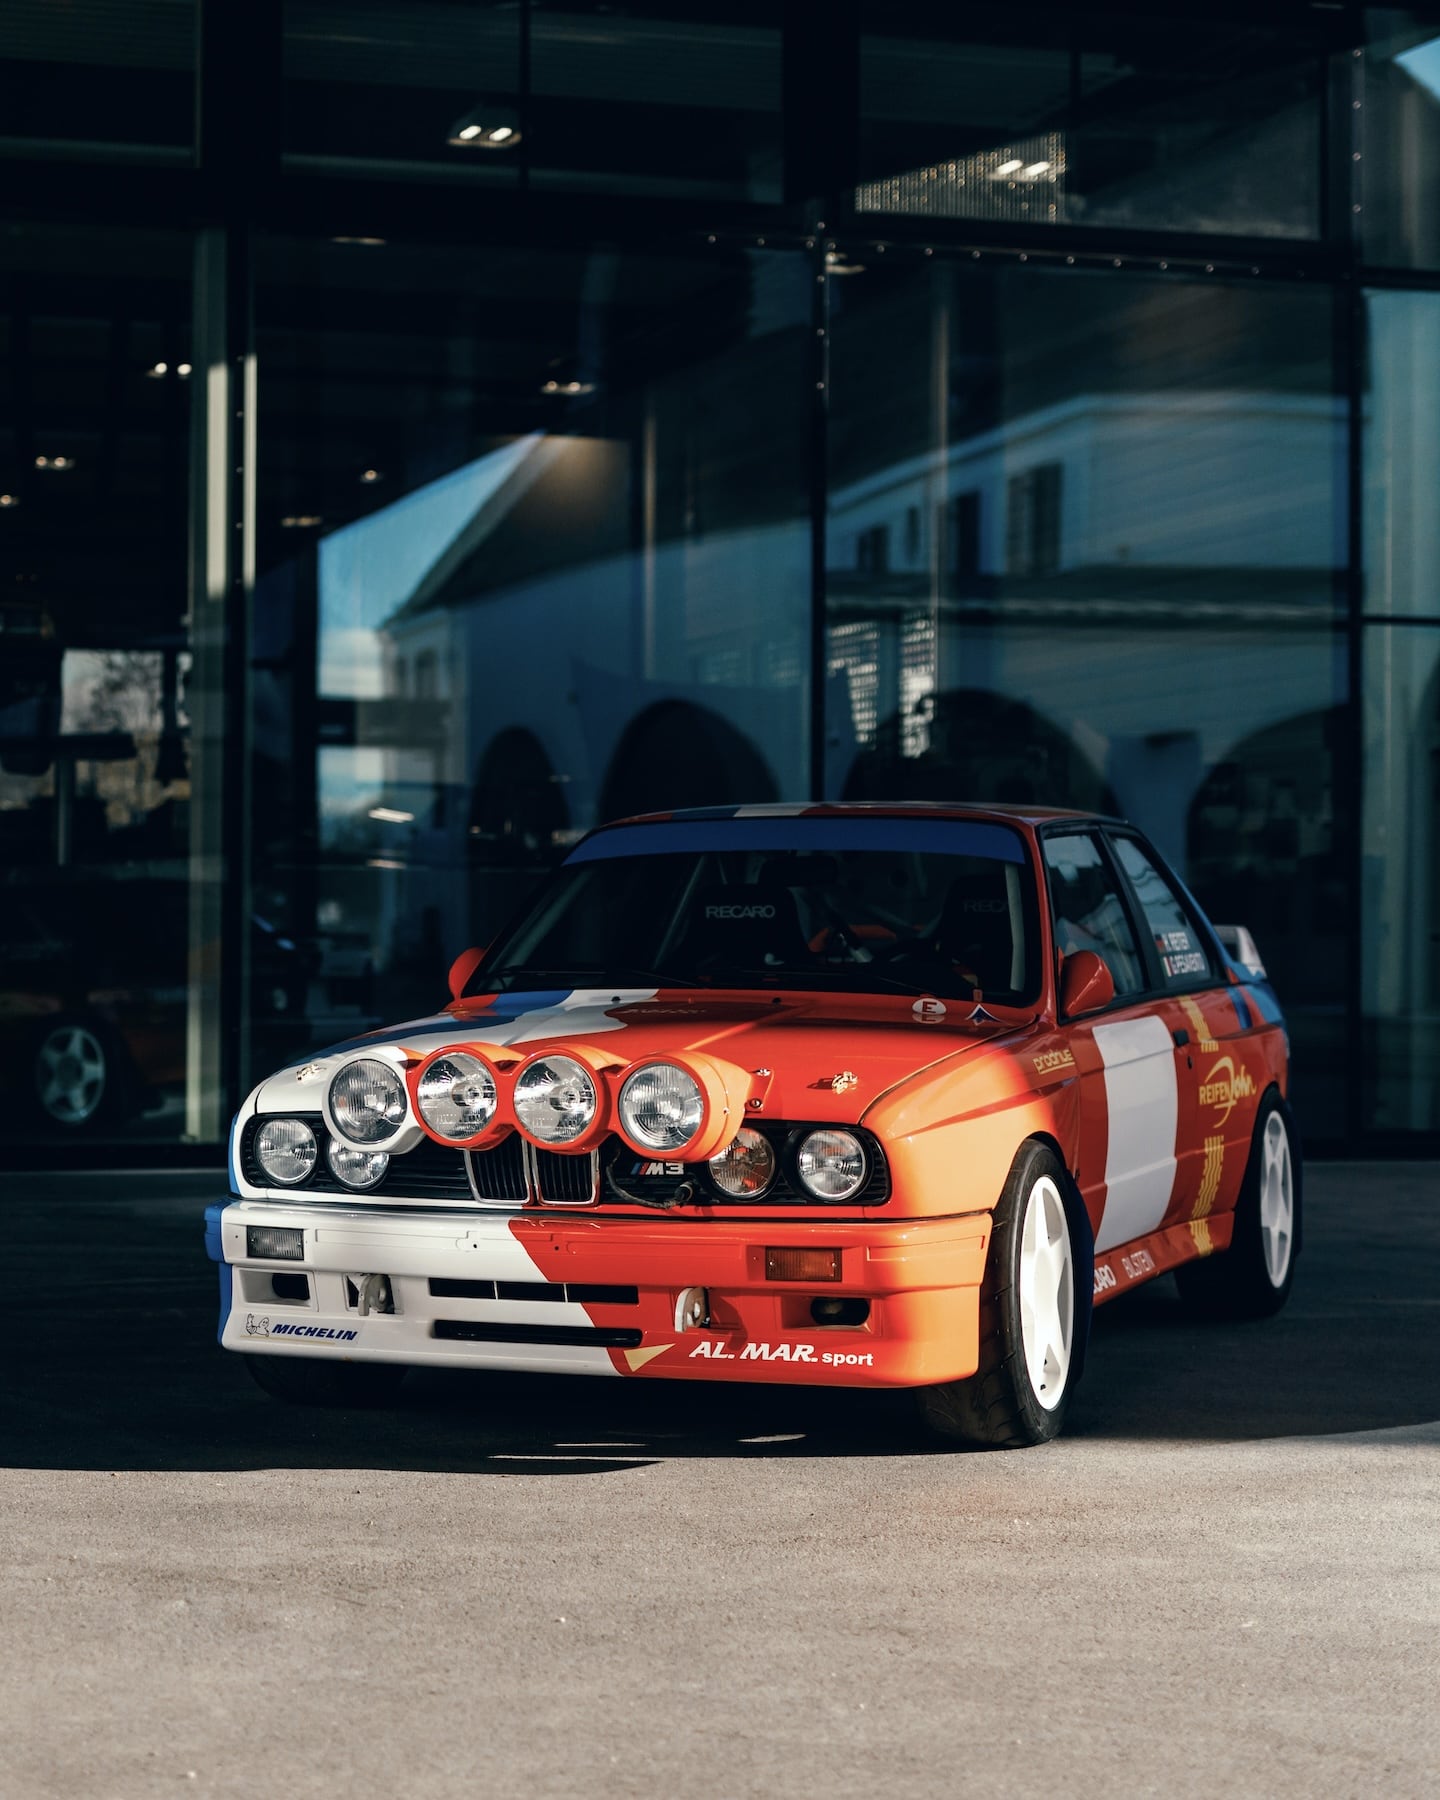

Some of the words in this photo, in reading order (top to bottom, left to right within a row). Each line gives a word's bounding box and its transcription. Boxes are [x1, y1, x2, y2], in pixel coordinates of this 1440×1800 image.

[705, 904, 776, 919] RECARO
[922, 1001, 937, 1014] E
[645, 1162, 685, 1175] M3
[272, 1323, 358, 1341] MICHELIN
[689, 1341, 735, 1359] AL.
[740, 1342, 818, 1363] MAR.
[822, 1352, 874, 1367] sport
